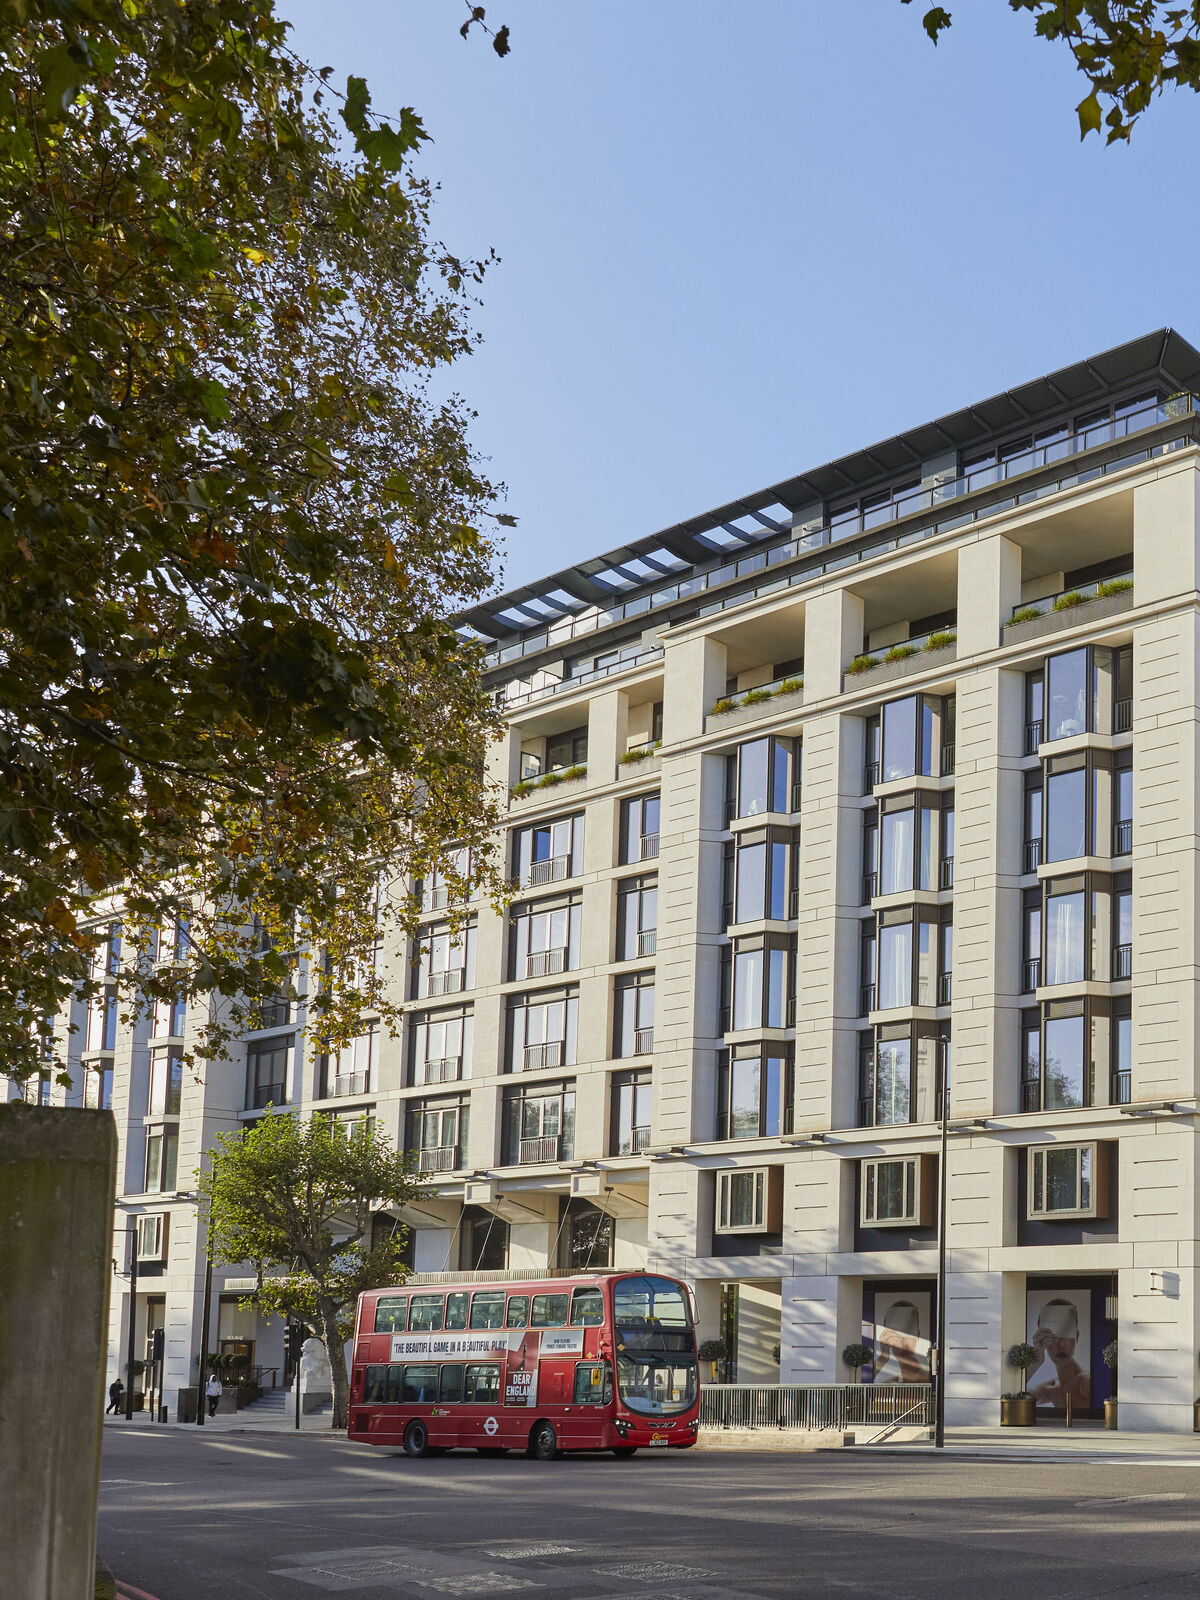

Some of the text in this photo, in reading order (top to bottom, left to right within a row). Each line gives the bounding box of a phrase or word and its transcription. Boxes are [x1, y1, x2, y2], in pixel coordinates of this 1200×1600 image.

[433, 1341, 449, 1353] GAME
[450, 1341, 456, 1352] IN
[456, 1341, 461, 1352] A
[513, 1374, 531, 1385] DEAR
[506, 1385, 536, 1396] ENGLAND
